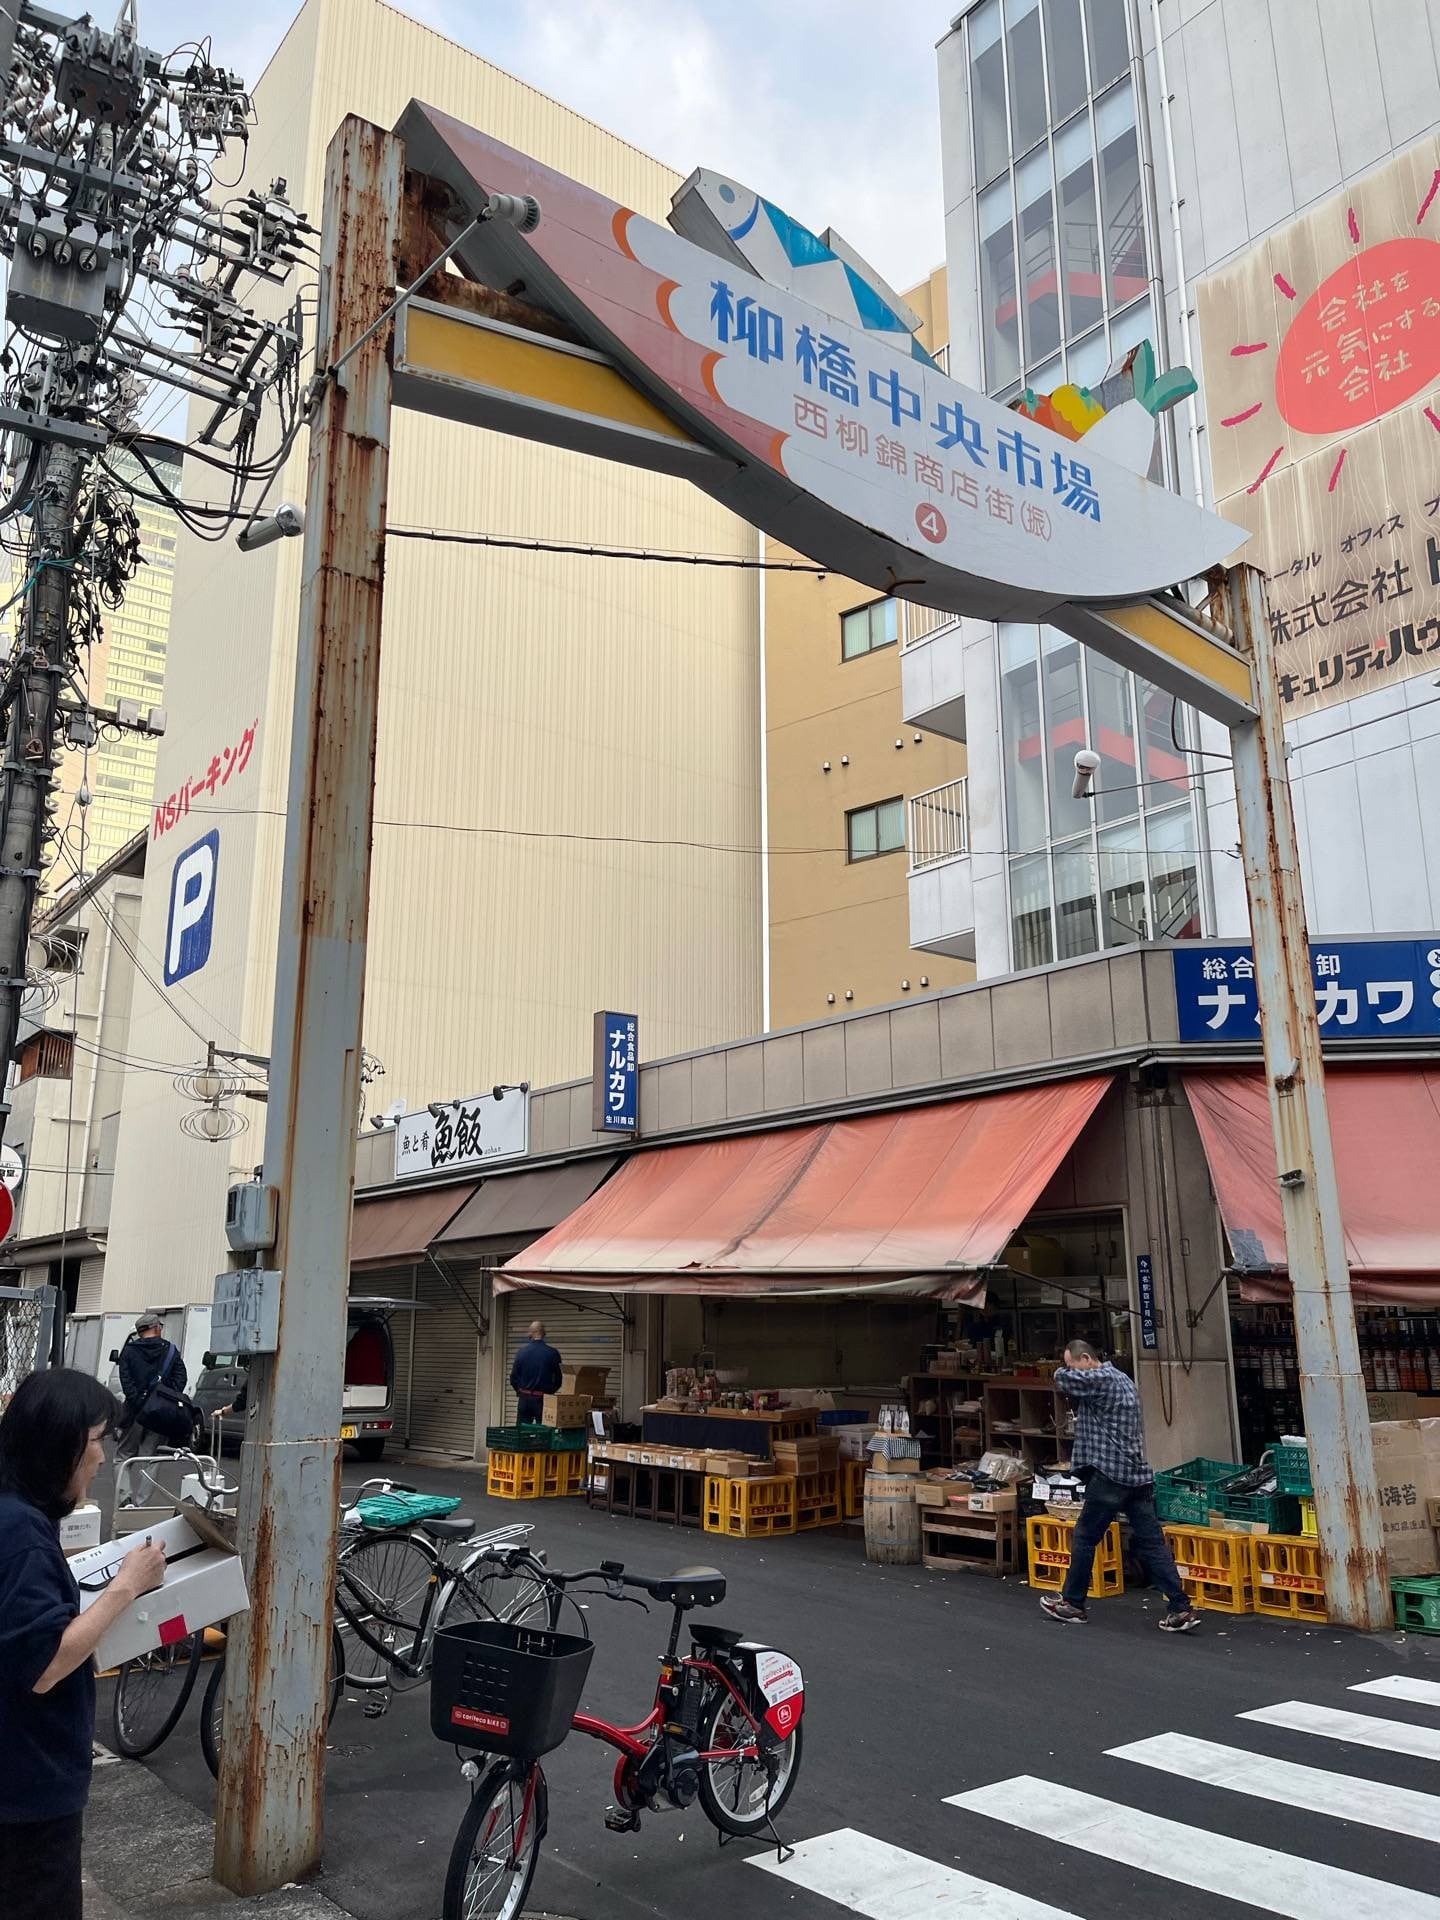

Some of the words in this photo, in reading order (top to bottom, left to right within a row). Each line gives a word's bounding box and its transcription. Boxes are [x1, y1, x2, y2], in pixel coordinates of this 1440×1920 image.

[1317, 271, 1409, 332] 会社を
[1301, 297, 1440, 384] 元気にする
[710, 280, 1101, 522] 柳橋中央市場
[1338, 349, 1412, 402] 会社
[1266, 551, 1322, 582] ータル
[1340, 514, 1405, 553] オフィス
[154, 718, 258, 841] NSパーキング
[168, 844, 213, 974] P
[1198, 981, 1414, 1030] ナカワ
[609, 1030, 626, 1111] ナルカワ
[431, 1106, 483, 1168] 魚飯
[605, 1115, 635, 1125] 生川商店
[1378, 1483, 1417, 1506] 海苔
